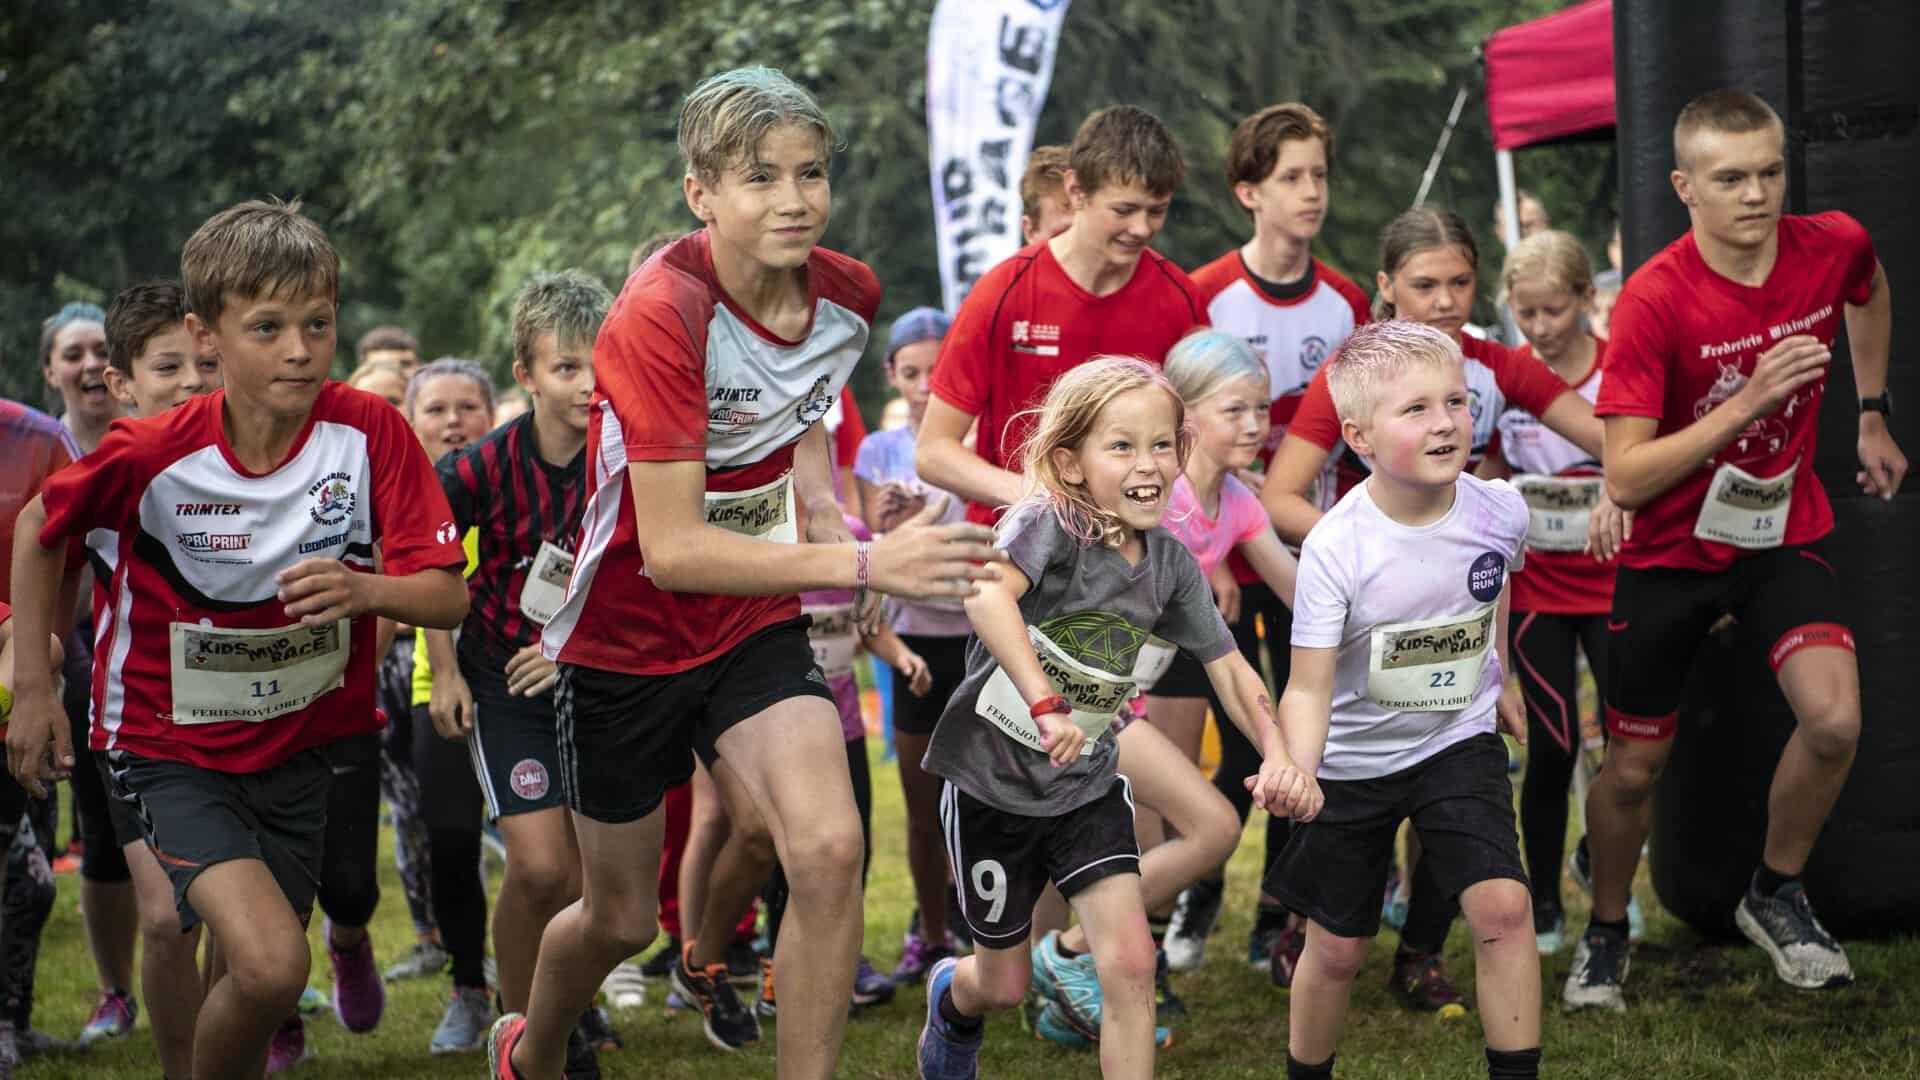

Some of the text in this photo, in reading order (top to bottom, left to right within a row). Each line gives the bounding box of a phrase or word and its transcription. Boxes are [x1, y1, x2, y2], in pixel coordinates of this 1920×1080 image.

[176, 503, 242, 516] TRIMTEX
[1752, 516, 1774, 530] 15
[1472, 577, 1495, 591] RUN
[1395, 635, 1435, 652] KIDS
[1433, 628, 1467, 653] MUD
[199, 639, 249, 656] KIDS
[271, 636, 328, 664] RACE
[1429, 670, 1456, 688] 22
[251, 679, 282, 698] 11
[1062, 681, 1100, 697] MUD
[1075, 694, 1116, 709] RACE
[971, 859, 1007, 923] 9
